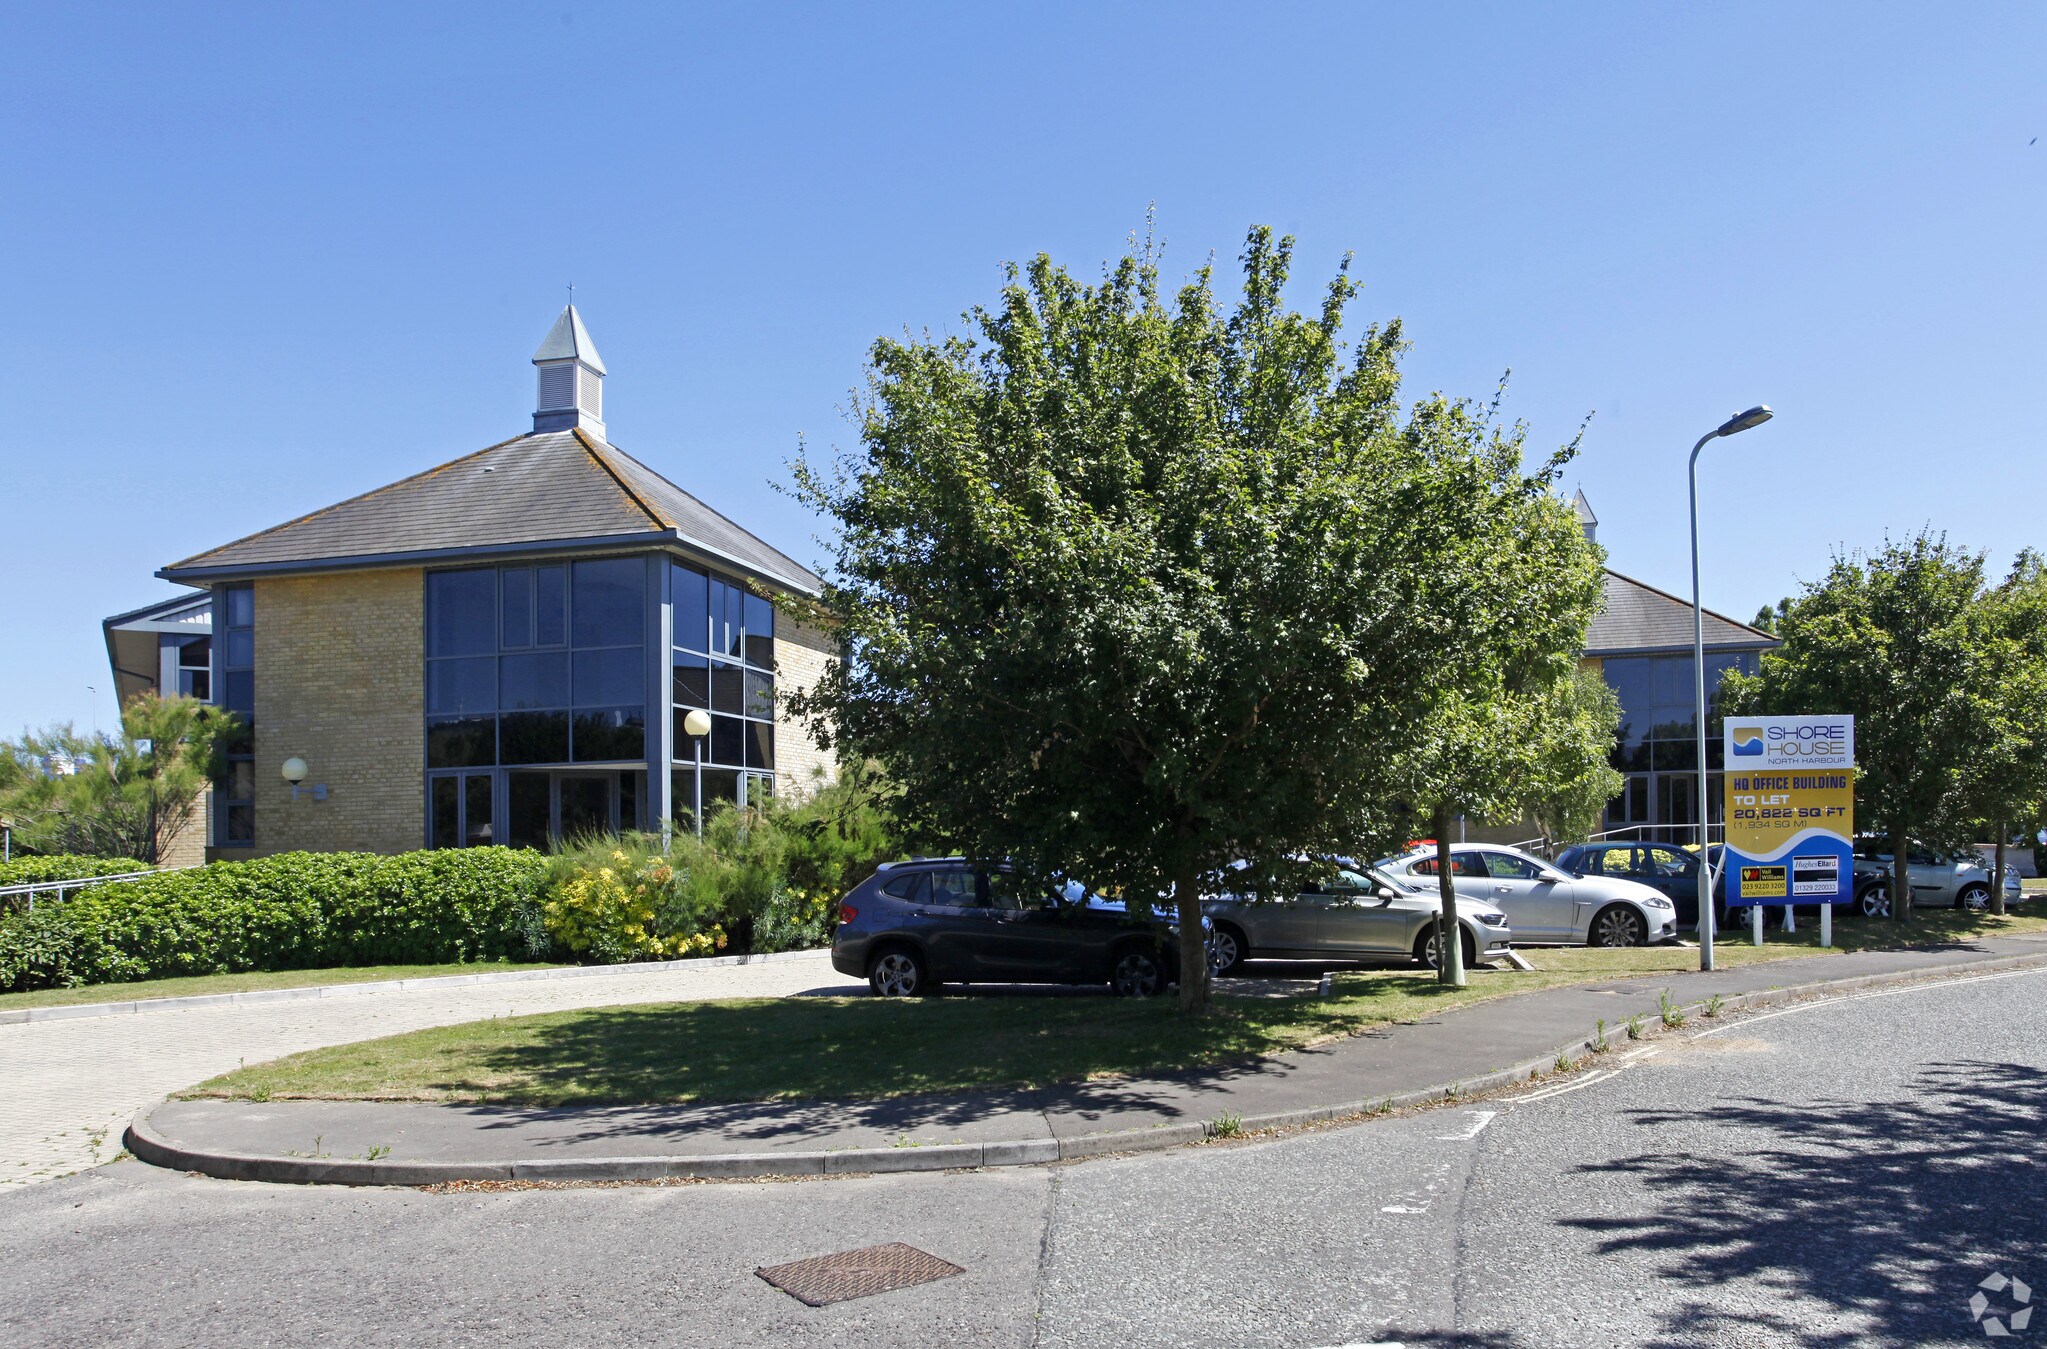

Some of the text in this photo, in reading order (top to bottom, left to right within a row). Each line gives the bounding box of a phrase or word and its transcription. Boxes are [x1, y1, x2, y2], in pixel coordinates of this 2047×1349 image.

[1768, 726, 1845, 740] SHORE
[1768, 741, 1845, 756] HOUSE
[1734, 776, 1847, 791] HQ OFFICE BUILDING
[1733, 794, 1790, 805] TO LET
[1734, 807, 1846, 820] 20,822 SQ FT
[1733, 820, 1807, 829] (1,934 SQ M)
